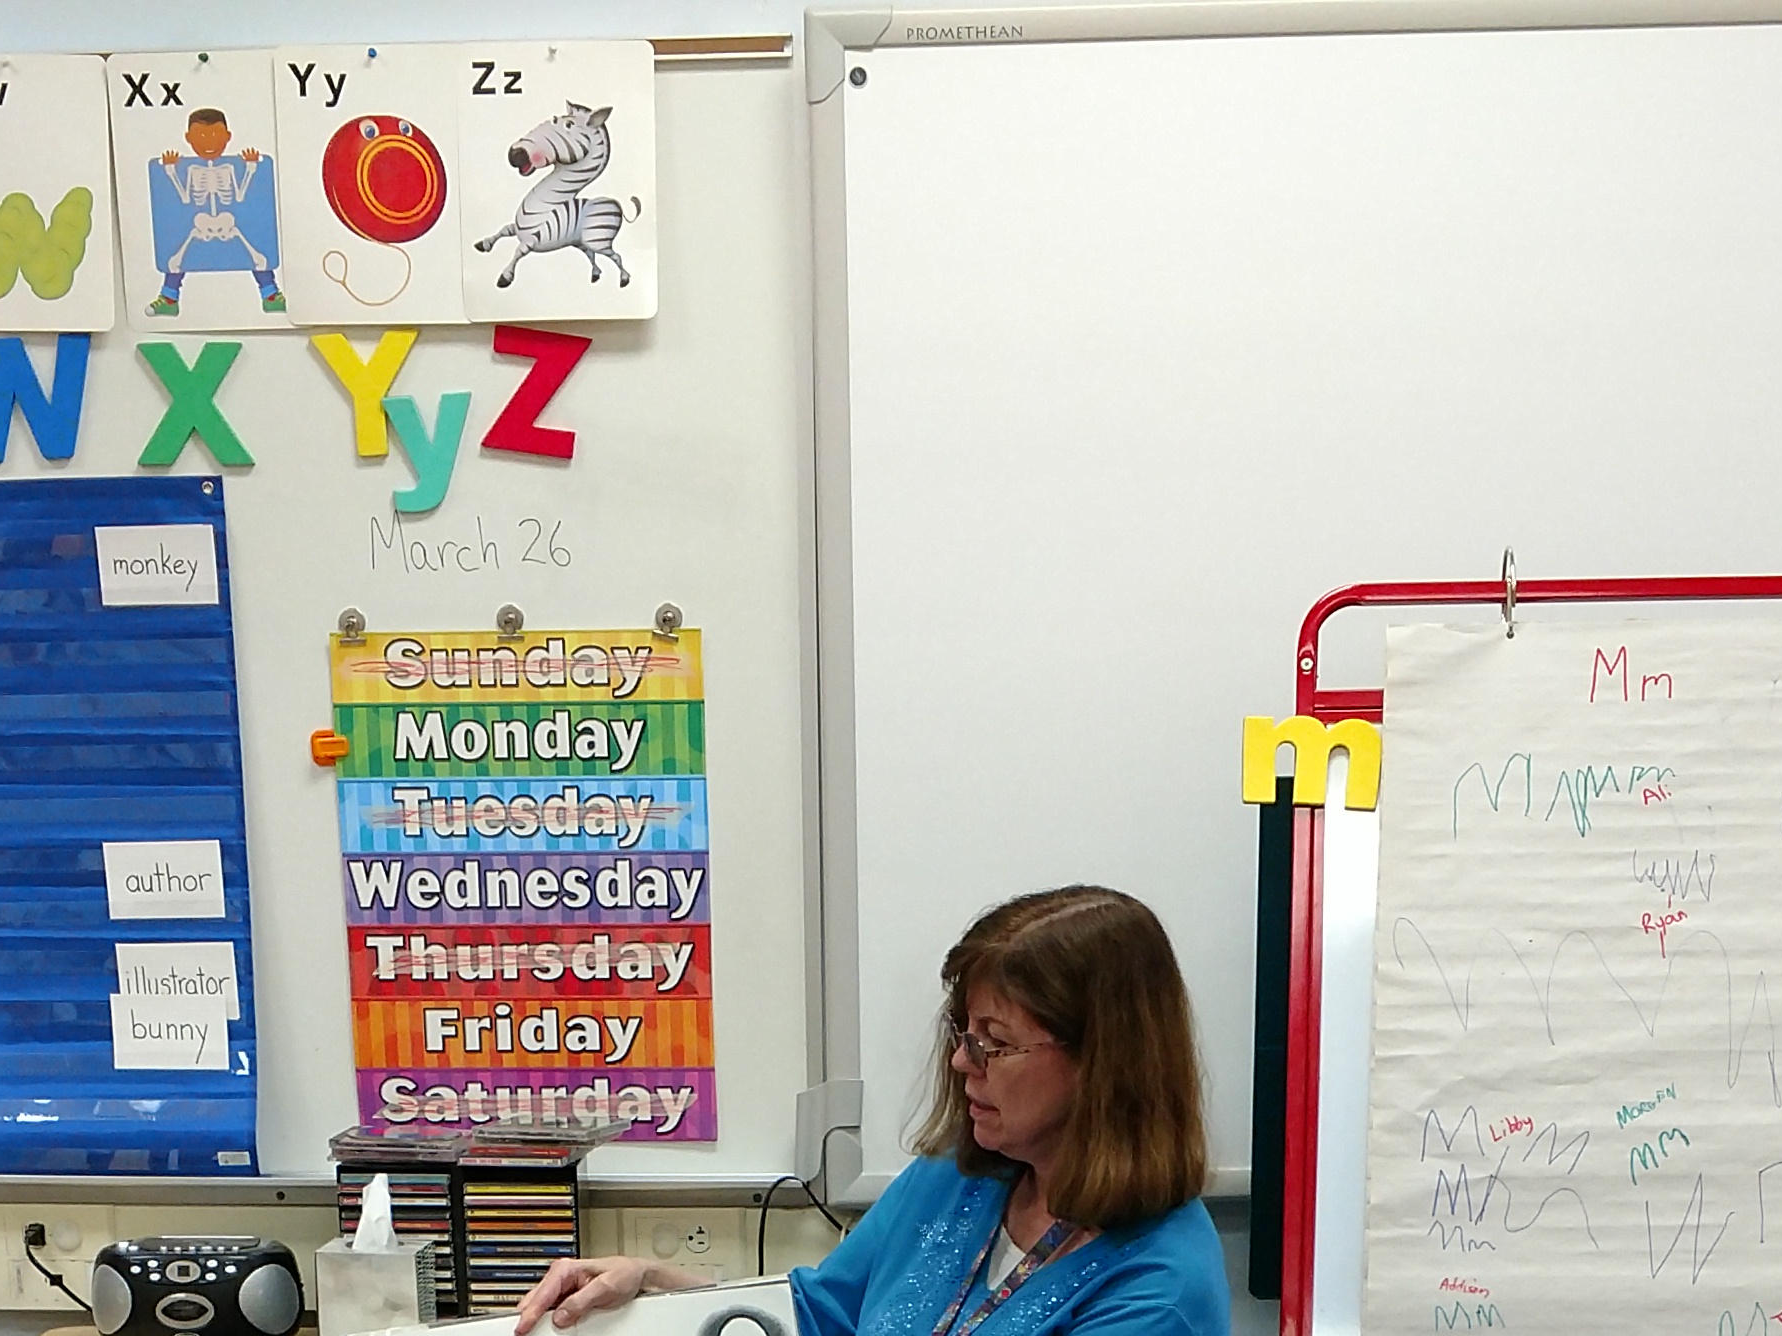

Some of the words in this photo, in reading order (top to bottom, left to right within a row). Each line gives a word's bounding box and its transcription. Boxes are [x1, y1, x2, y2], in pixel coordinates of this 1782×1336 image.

[905, 24, 1025, 41] PROMETHEAN
[121, 72, 184, 108] Xx
[288, 62, 347, 108] Yy
[471, 61, 523, 96] Zz
[111, 543, 200, 593] monkey
[369, 511, 500, 574] March
[518, 519, 572, 568] 26
[383, 636, 654, 697] Sunday
[1589, 645, 1673, 703] Mm
[392, 708, 646, 771] Monday
[1242, 714, 1383, 812] m
[391, 785, 656, 848] Tuesday
[124, 864, 213, 897] author
[346, 858, 706, 921] Wednesday
[1641, 909, 1689, 936] Ryan
[124, 964, 231, 998] illustrator
[364, 931, 695, 993] Thursday
[130, 1007, 209, 1067] bunny
[422, 1003, 644, 1064] Friday
[377, 1076, 695, 1137] Saturday
[1489, 1114, 1535, 1143] Libby
